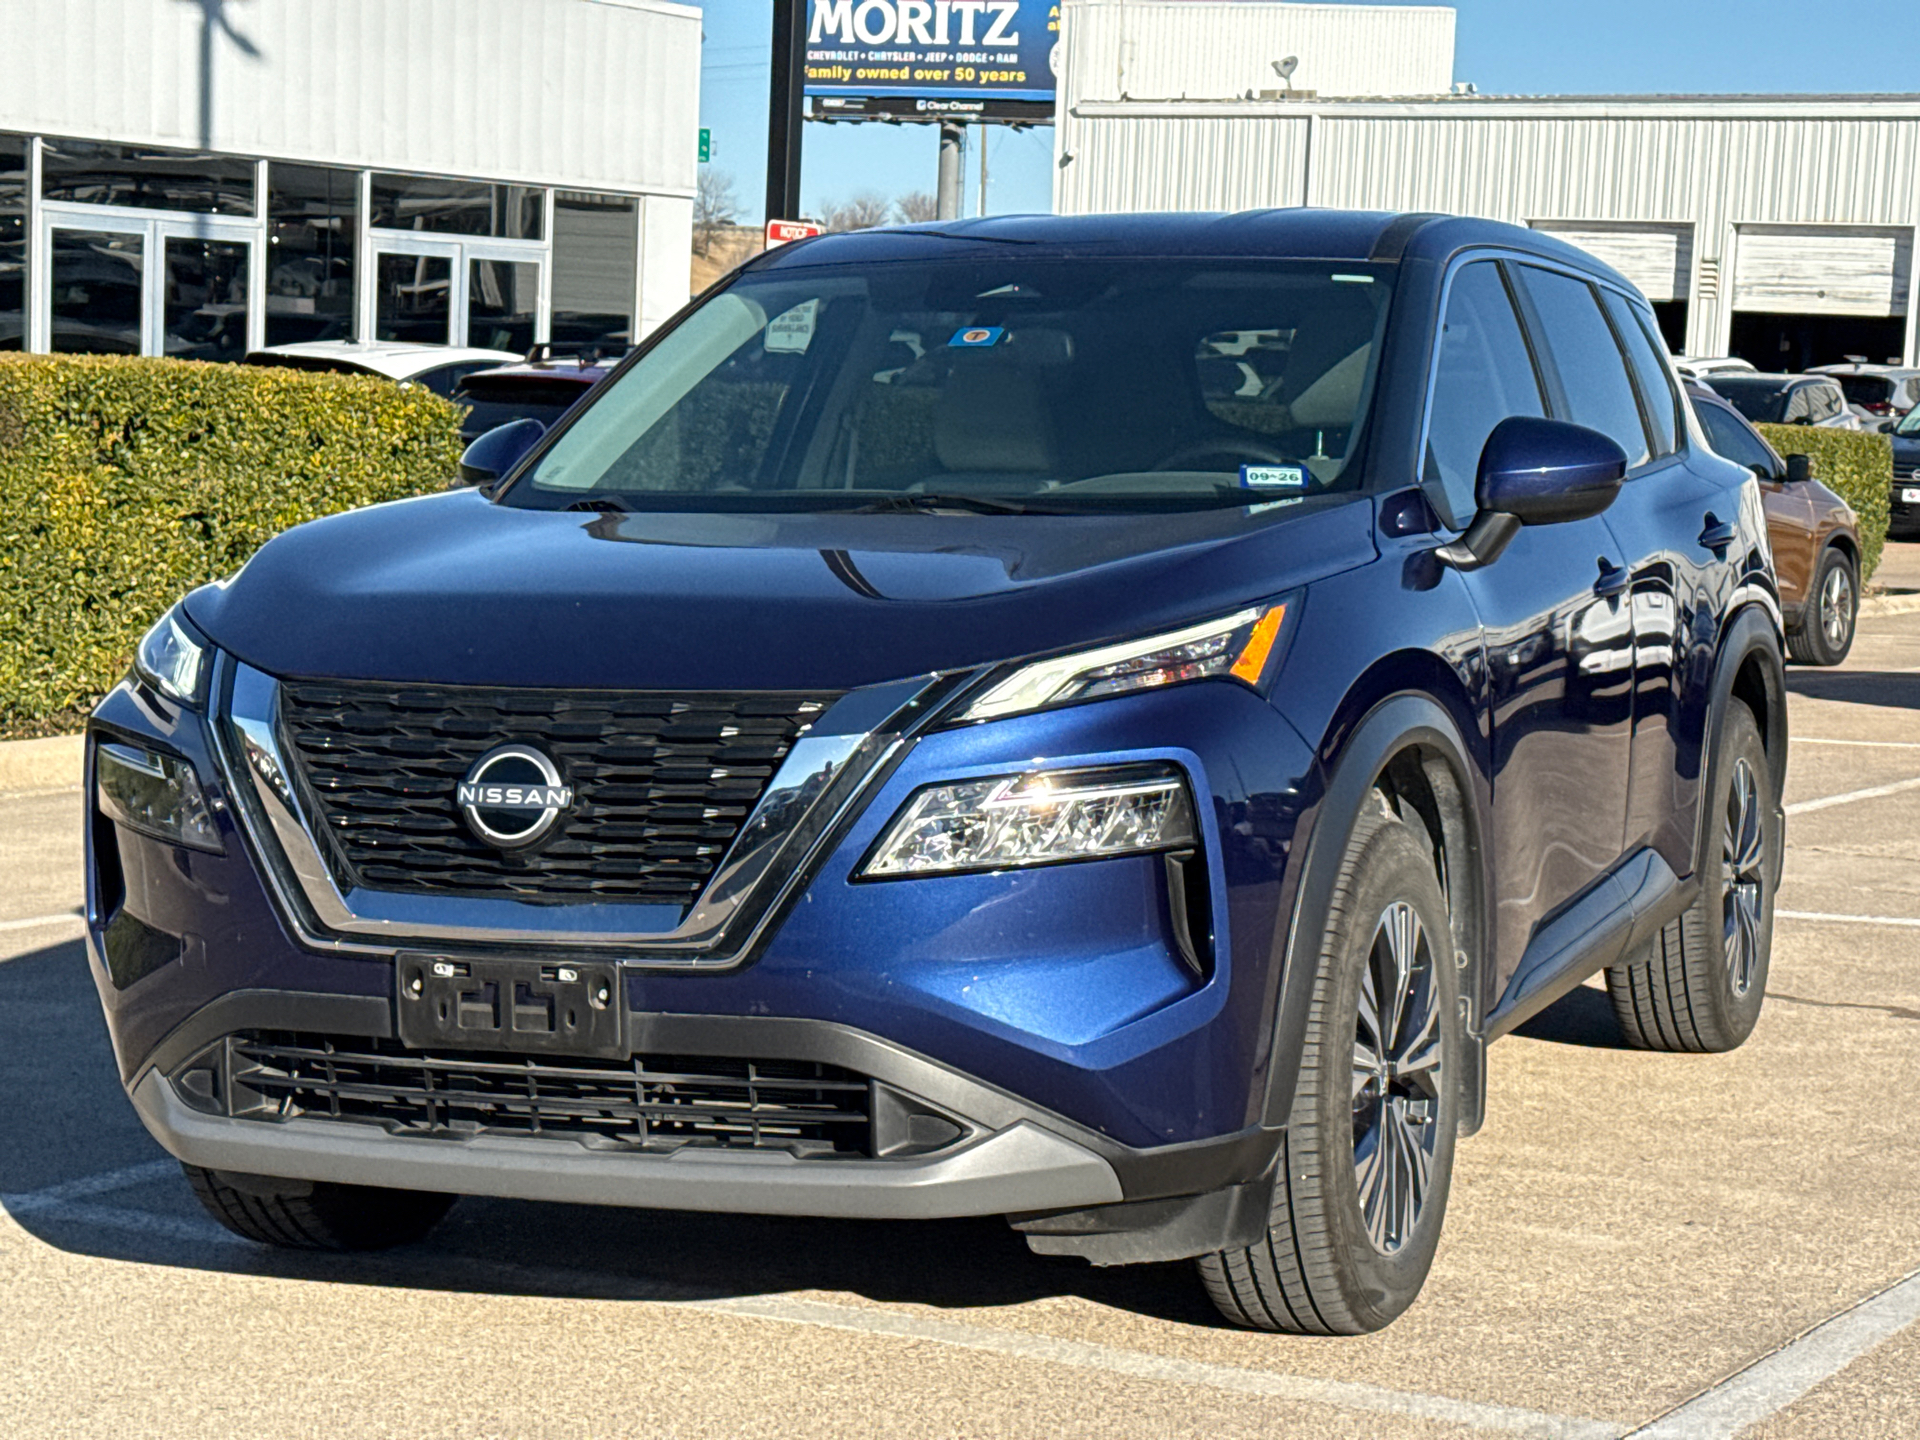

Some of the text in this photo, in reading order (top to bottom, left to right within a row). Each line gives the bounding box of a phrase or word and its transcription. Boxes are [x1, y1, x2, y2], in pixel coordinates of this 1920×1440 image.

[808, 0, 1019, 45] MORITZ
[807, 50, 1018, 63] CHEVROLET CHRYSLER JEEP DODGE RAM
[856, 66, 910, 80] owned
[914, 69, 951, 80] over
[955, 67, 975, 81] 50
[979, 71, 1026, 84] years
[927, 101, 984, 111] Clear Channel
[460, 786, 566, 805] NISSAN
